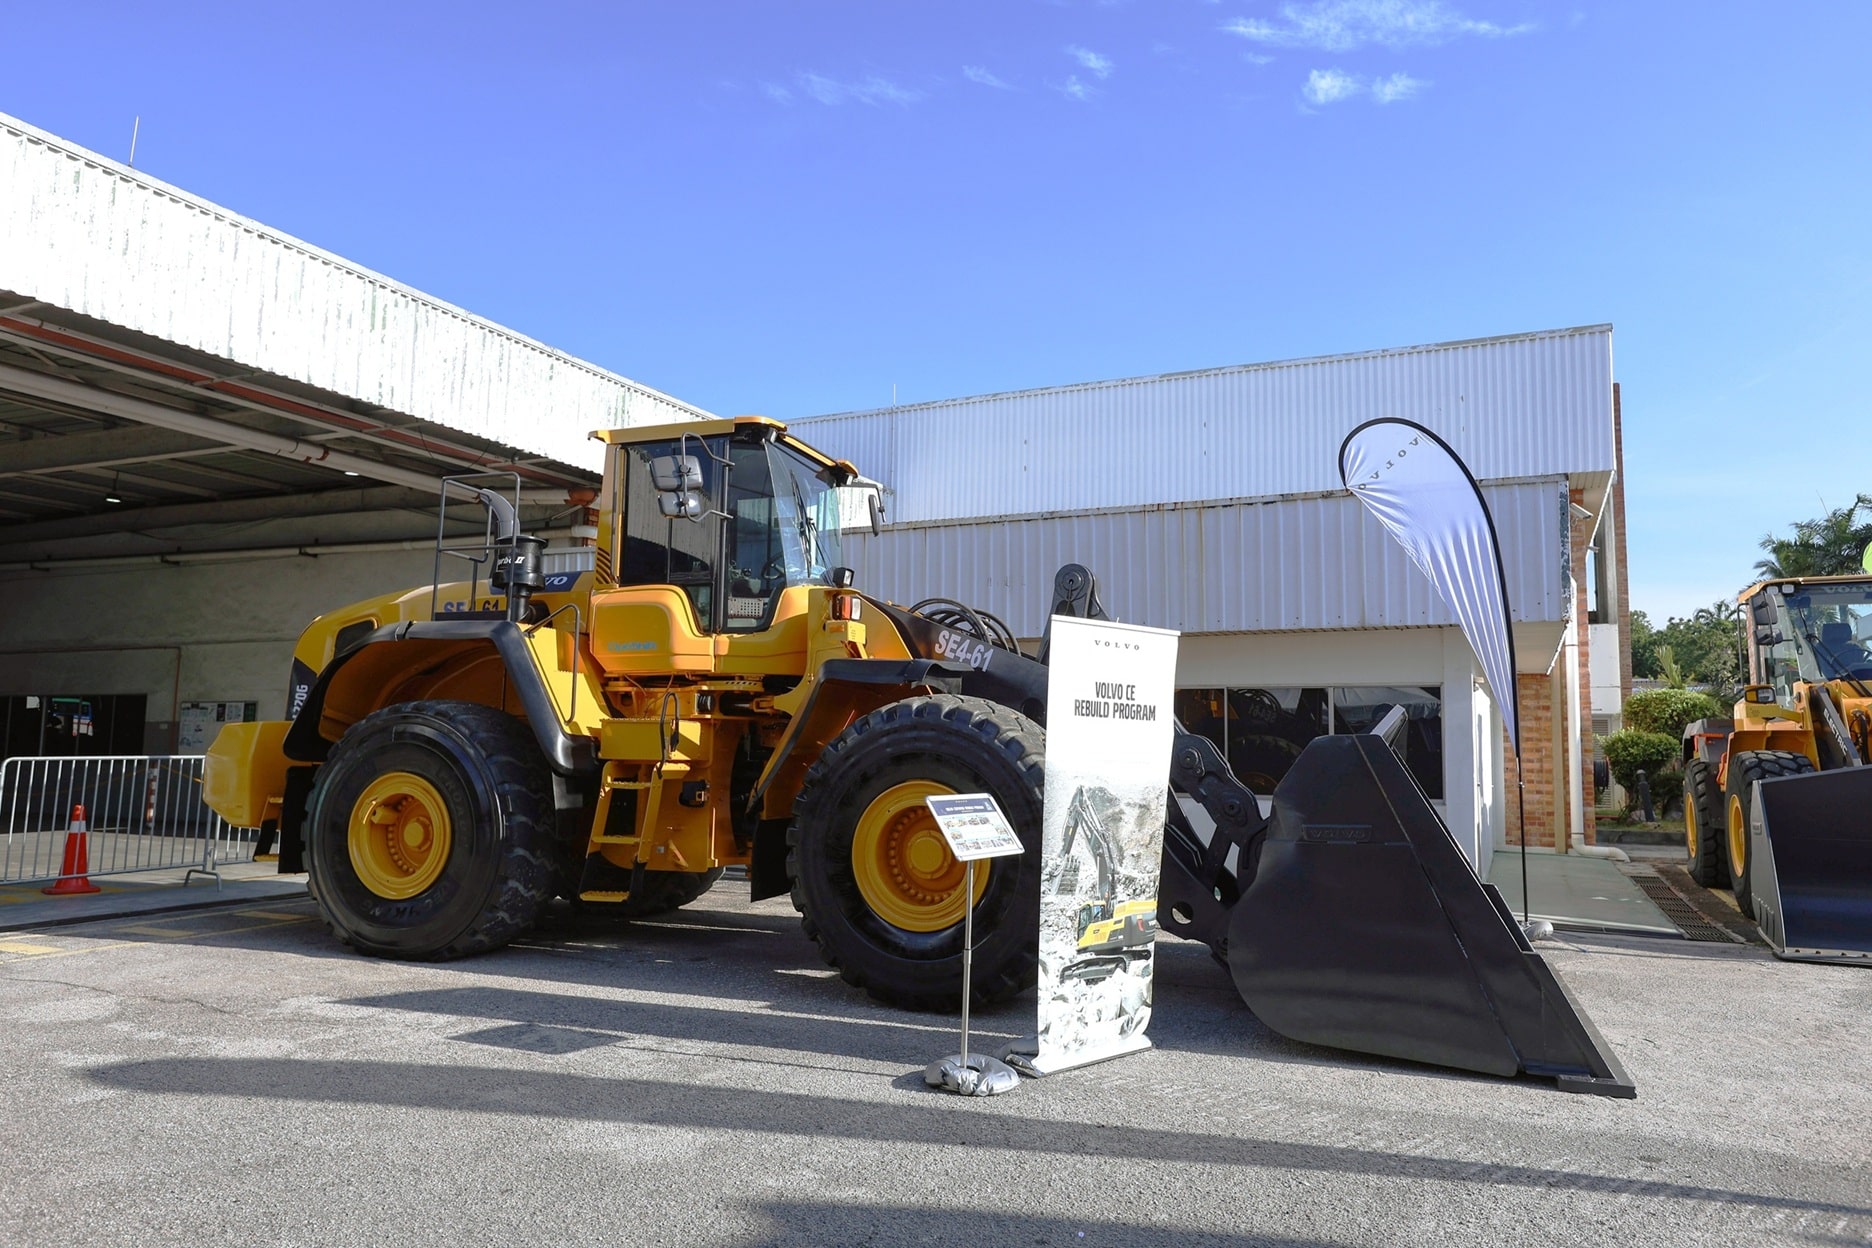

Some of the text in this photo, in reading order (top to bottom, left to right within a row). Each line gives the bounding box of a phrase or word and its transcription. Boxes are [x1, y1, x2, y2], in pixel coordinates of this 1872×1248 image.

[934, 630, 994, 673] SE4-61
[1094, 639, 1140, 651] VOLVO
[1095, 681, 1136, 701] VOLVO CE
[1074, 699, 1156, 721] REBUILD PROGRAM
[1823, 707, 1848, 756] ELECTRIC
